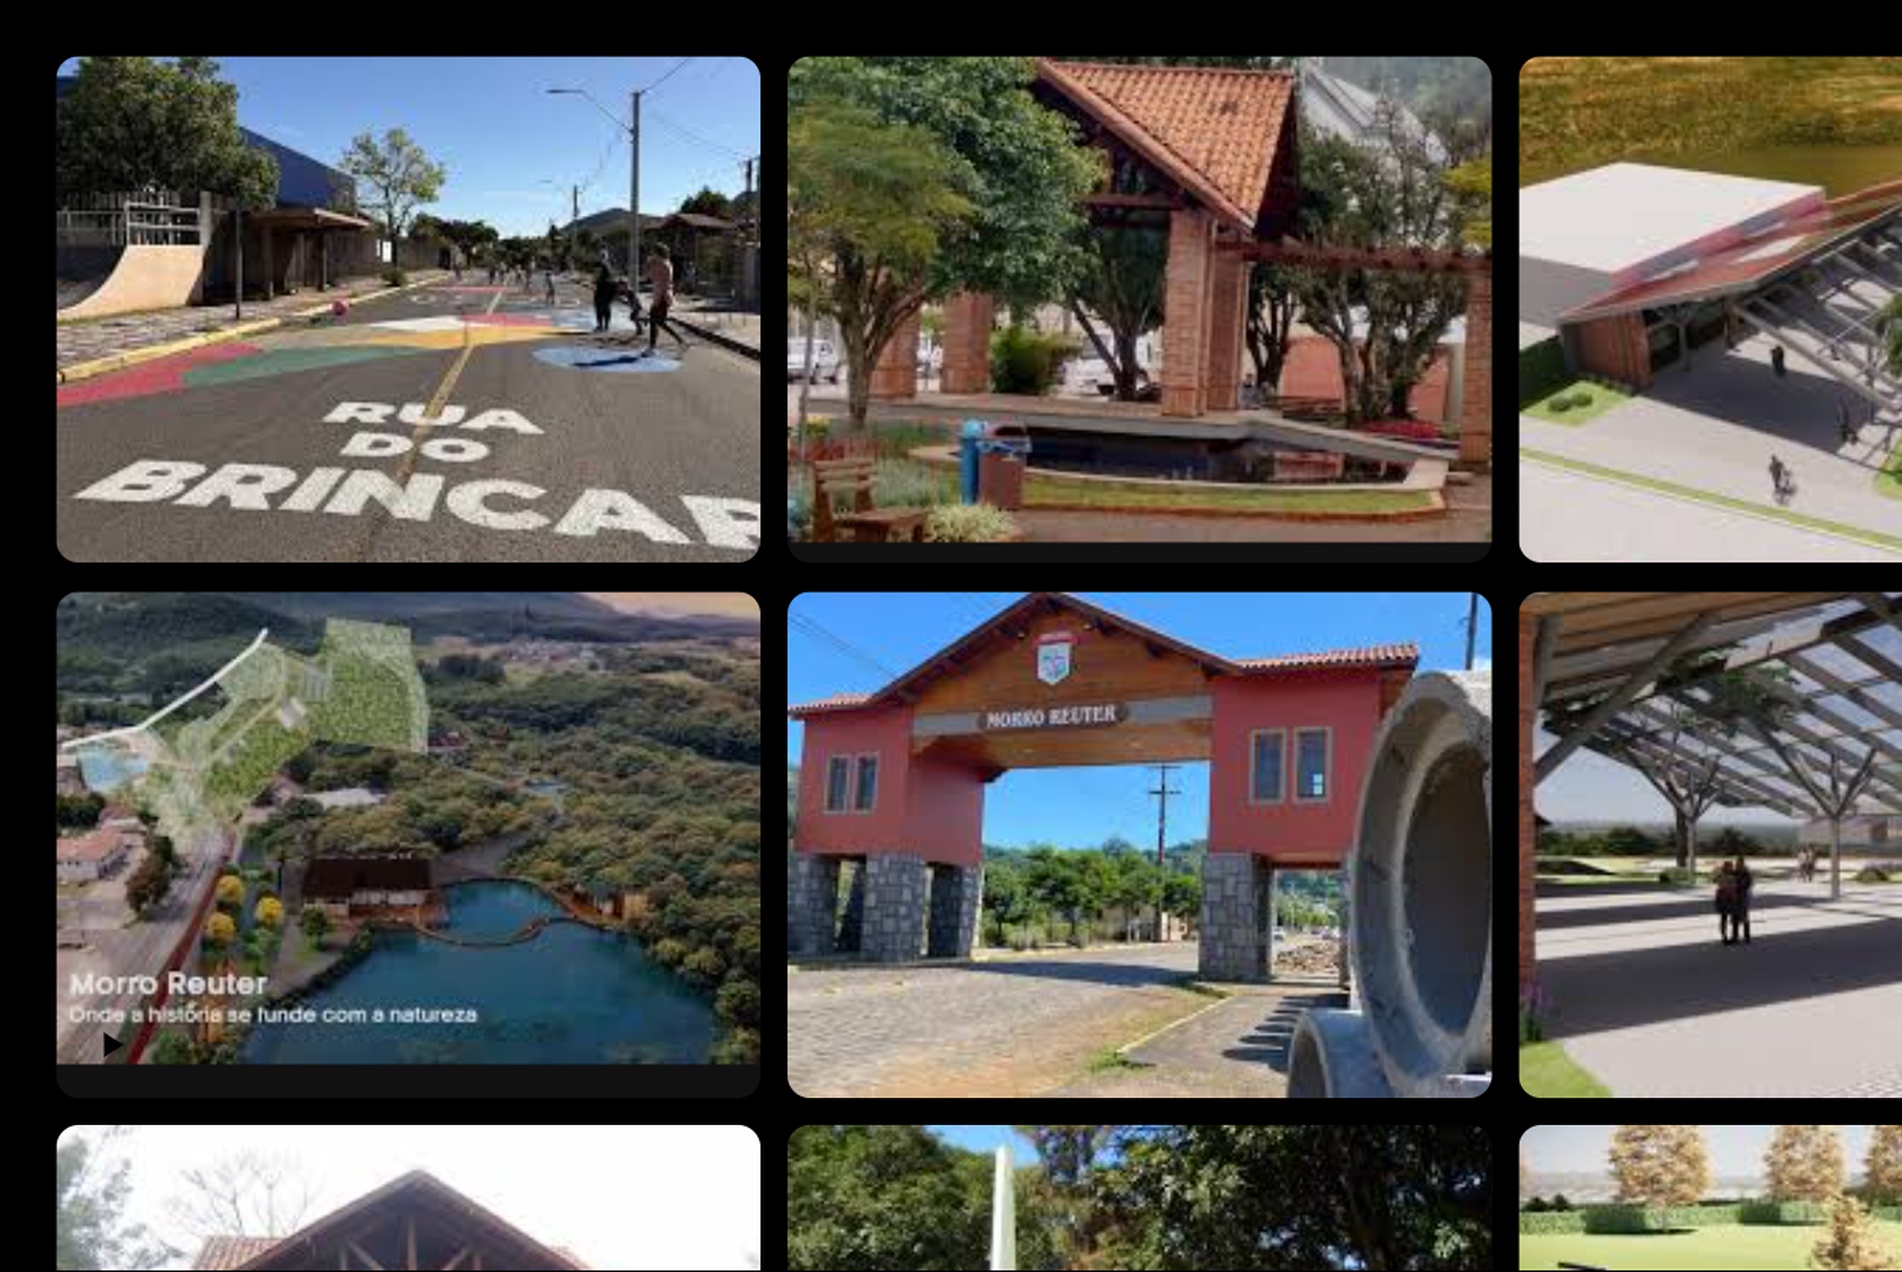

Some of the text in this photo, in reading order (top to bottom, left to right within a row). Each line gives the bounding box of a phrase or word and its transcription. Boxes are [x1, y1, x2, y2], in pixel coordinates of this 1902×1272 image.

[322, 401, 545, 434] RUA
[340, 431, 490, 462] DO
[986, 704, 1116, 728] MORRO REUTER
